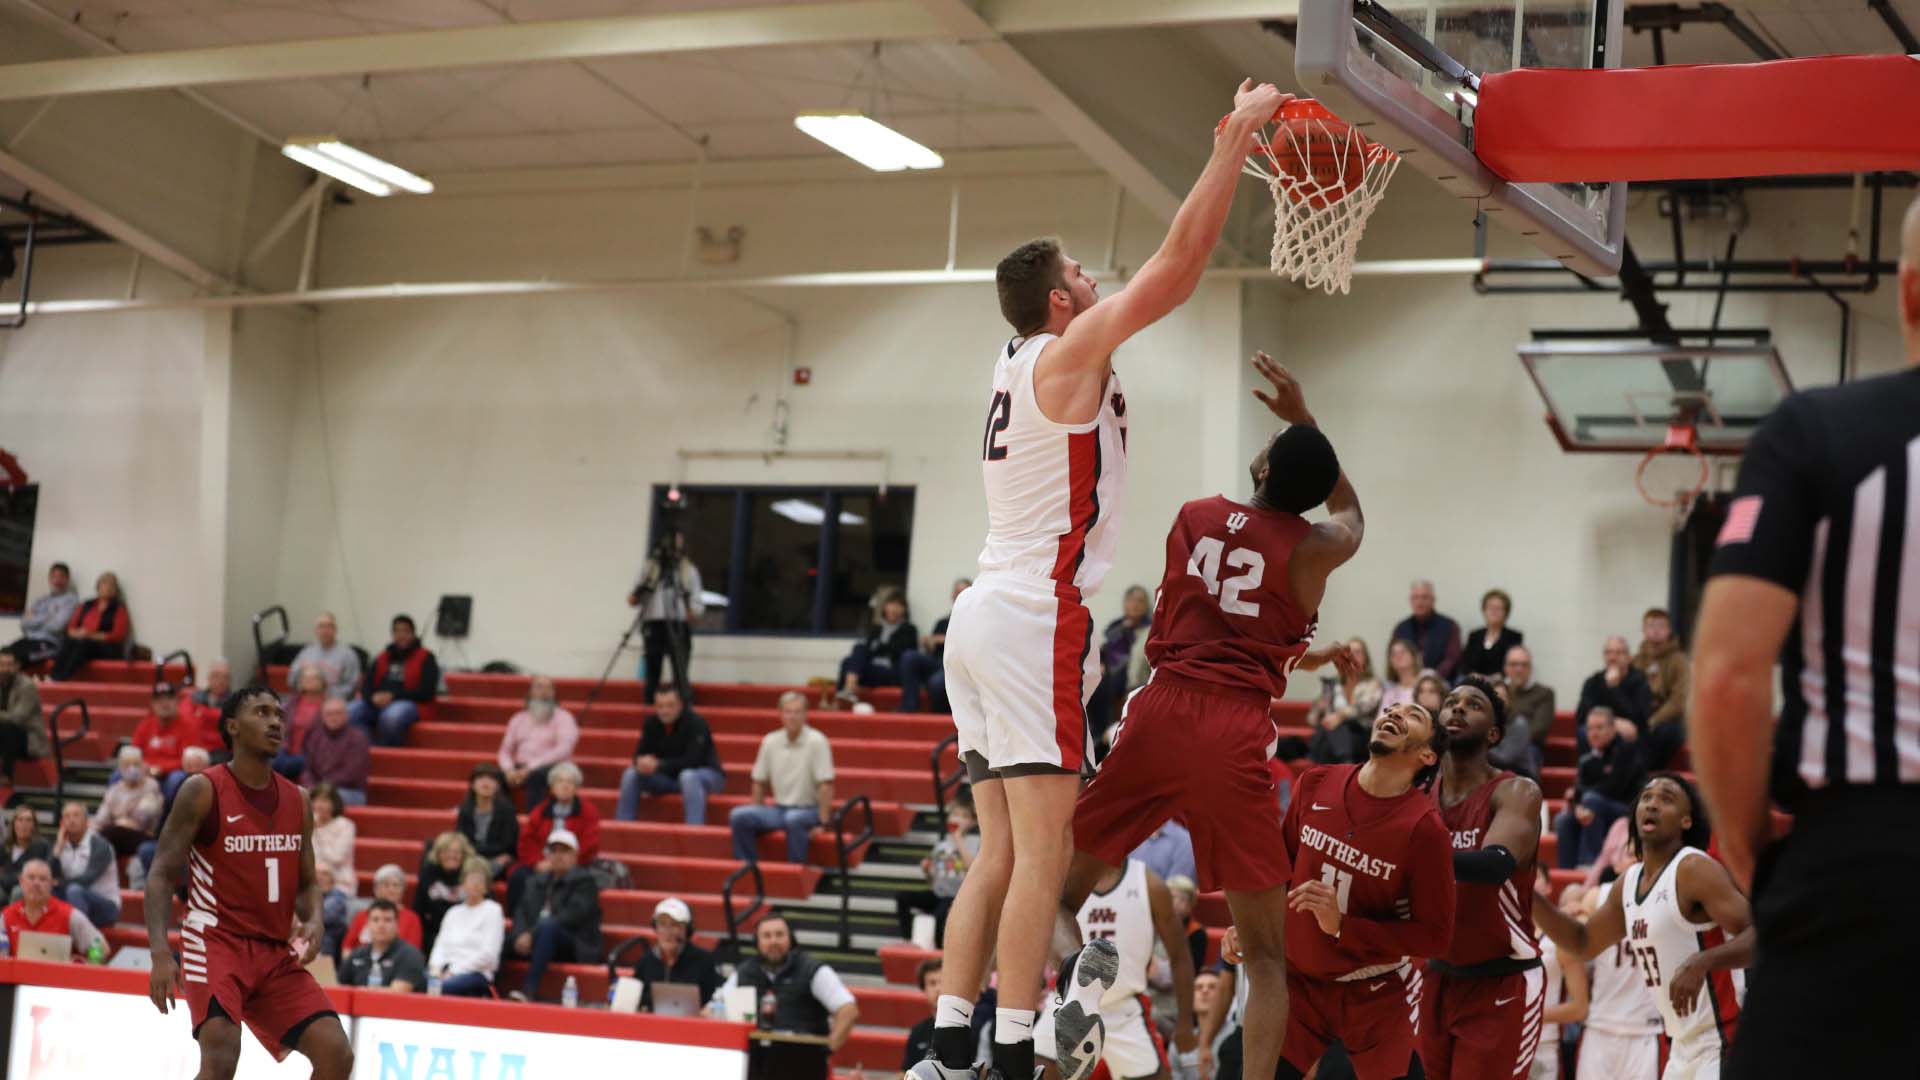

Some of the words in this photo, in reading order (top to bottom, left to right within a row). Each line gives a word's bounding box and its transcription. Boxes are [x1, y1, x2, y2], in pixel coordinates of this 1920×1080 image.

[982, 389, 1012, 461] 12
[1186, 535, 1266, 618] 42
[223, 833, 303, 853] SOUTHEAST
[1300, 824, 1397, 881] SOUTHEAST
[264, 857, 280, 903] 1
[1636, 945, 1662, 988] 33
